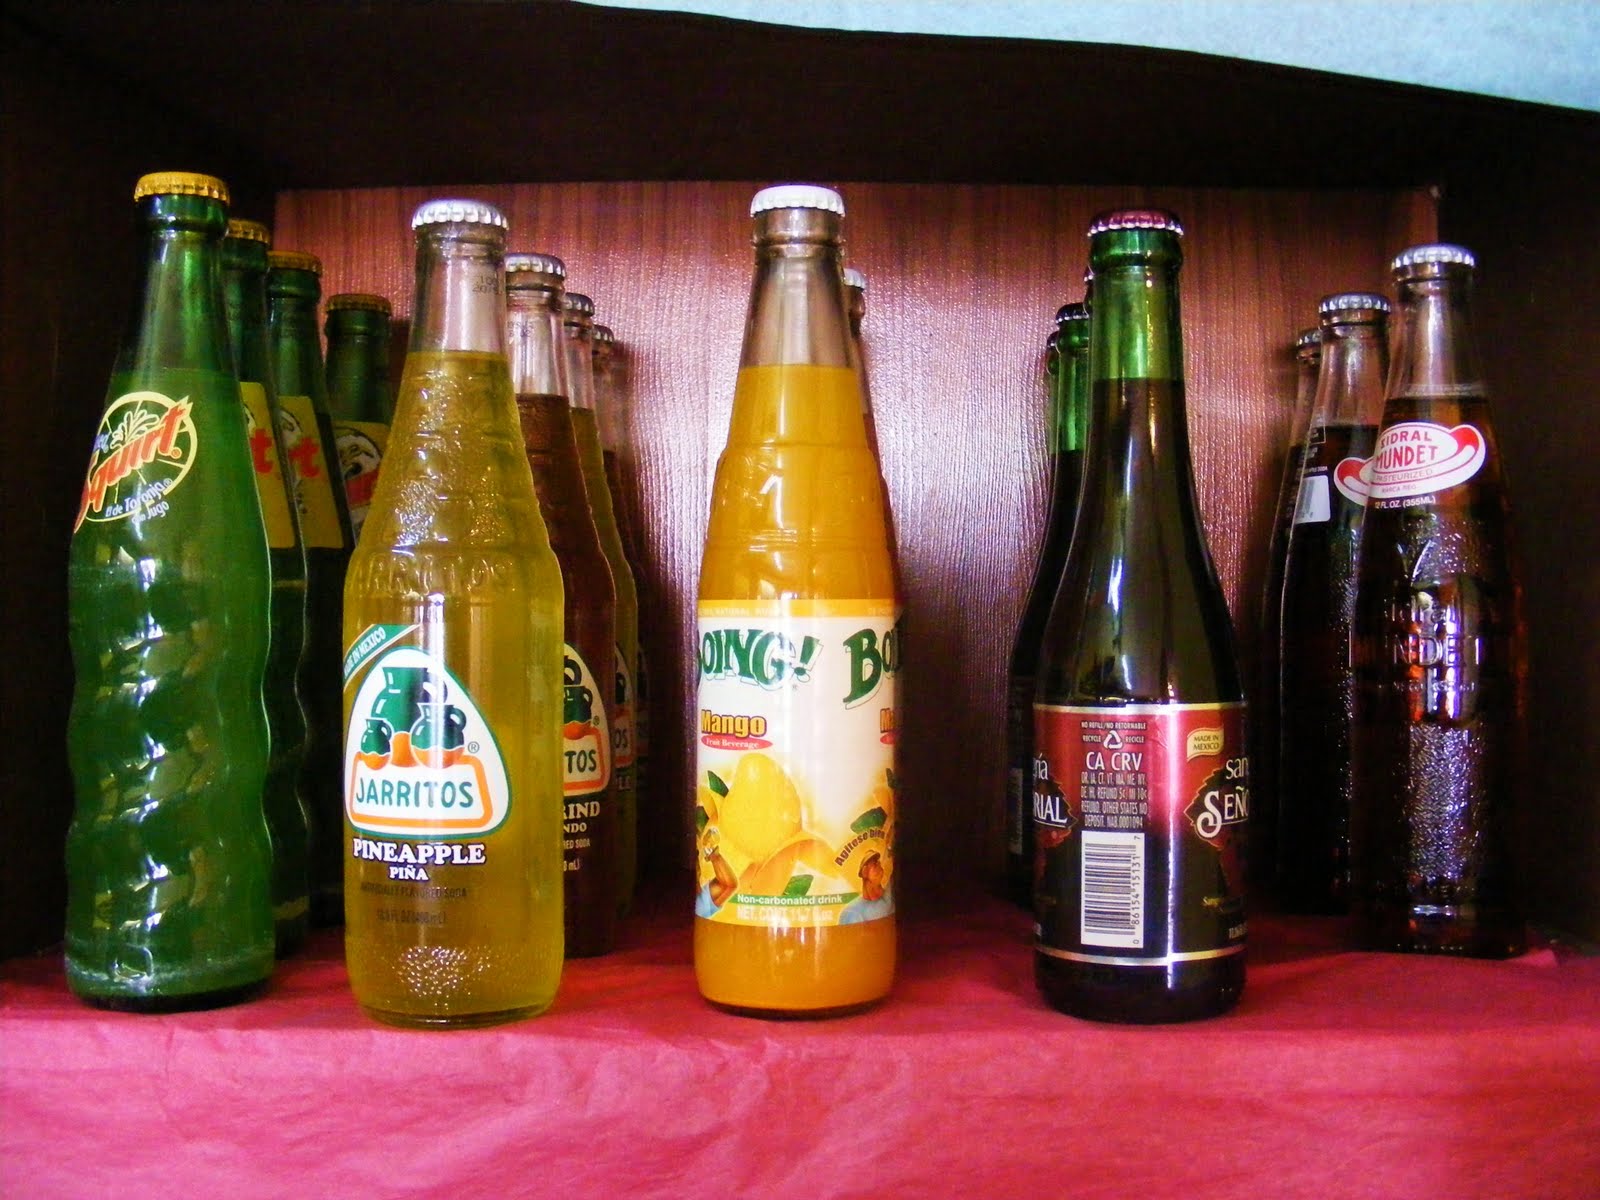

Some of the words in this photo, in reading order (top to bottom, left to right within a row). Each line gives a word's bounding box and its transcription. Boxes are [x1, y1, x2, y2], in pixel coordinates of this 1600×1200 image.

[1381, 430, 1433, 447] SIDRAL
[1376, 445, 1439, 470] MUNDET
[124, 481, 166, 511] Toronja
[1402, 495, 1437, 508] (355ML)
[358, 626, 387, 657] MEXICO
[698, 628, 824, 688] OING!
[701, 709, 767, 739] Mango
[1082, 735, 1102, 743] RECYCLE
[1193, 742, 1220, 751] MEXICO
[1194, 735, 1211, 743] MADE
[1086, 751, 1106, 770] CA
[1111, 752, 1143, 771] CRV
[356, 777, 474, 808] JARRITOS
[1102, 801, 1119, 814] OTHER
[1120, 801, 1138, 815] STATES
[352, 837, 486, 865] PINEAPPLE
[388, 864, 430, 881] PIÑA
[1132, 856, 1141, 887] 15131
[736, 894, 816, 906] Non-carbonated
[817, 894, 843, 905] drink
[1131, 893, 1140, 925] 86154
